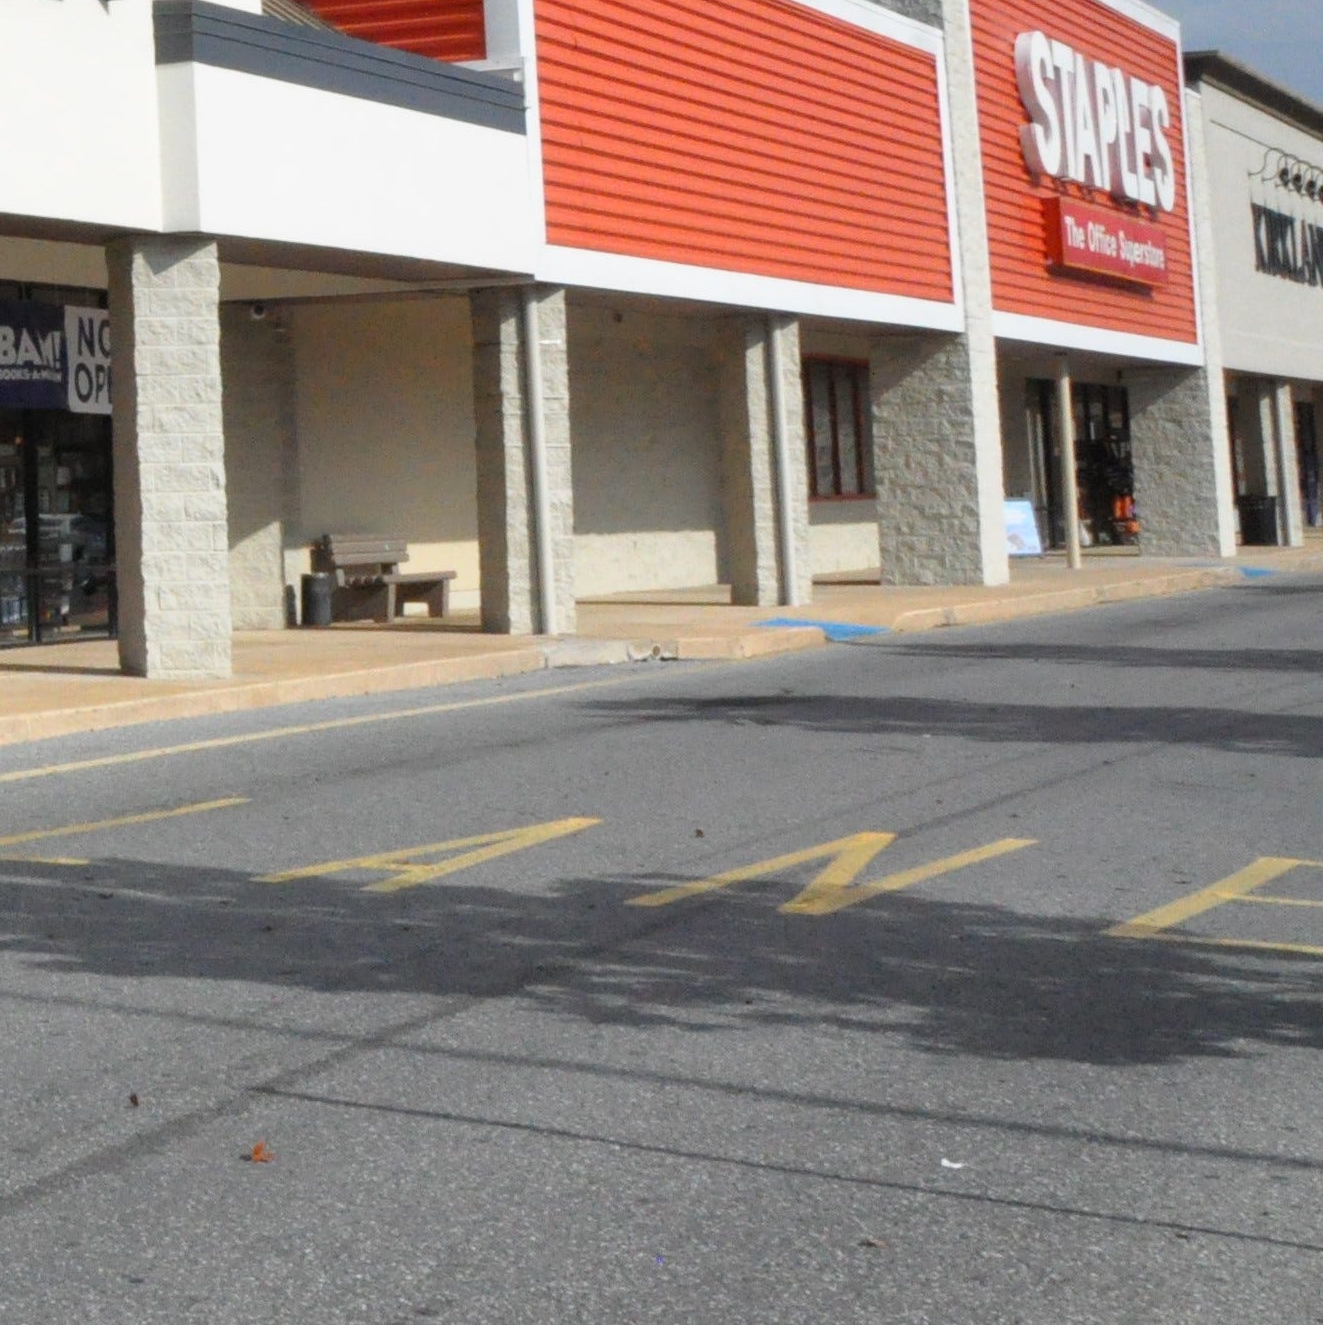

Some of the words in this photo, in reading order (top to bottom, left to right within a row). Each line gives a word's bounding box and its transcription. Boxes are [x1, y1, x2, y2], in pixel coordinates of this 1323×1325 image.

[1015, 30, 1175, 212] STAPLES
[1064, 215, 1085, 250] The
[1087, 221, 1117, 258] Office
[1118, 229, 1165, 270] Superstore
